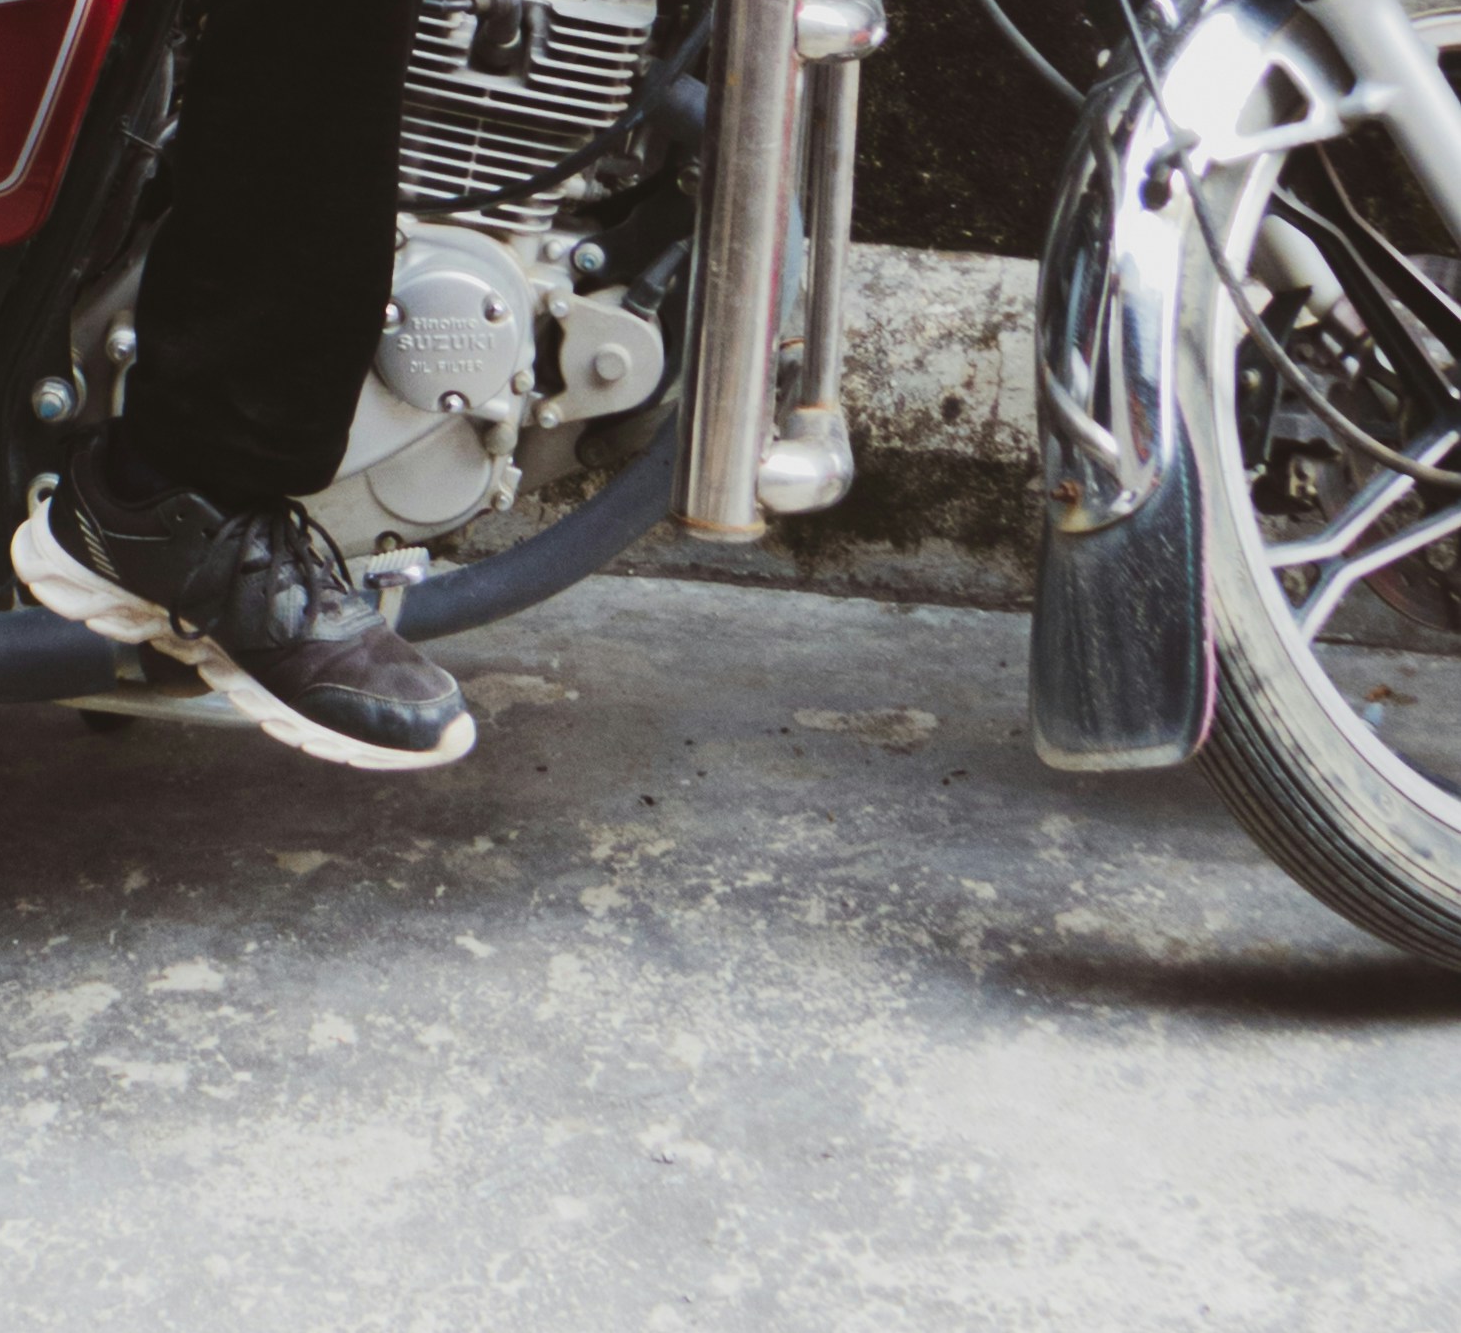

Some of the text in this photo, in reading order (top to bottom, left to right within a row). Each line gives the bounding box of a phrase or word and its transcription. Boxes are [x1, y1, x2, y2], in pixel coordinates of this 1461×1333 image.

[397, 333, 495, 351] SUZUKI
[410, 359, 484, 374] OIL FILTER
